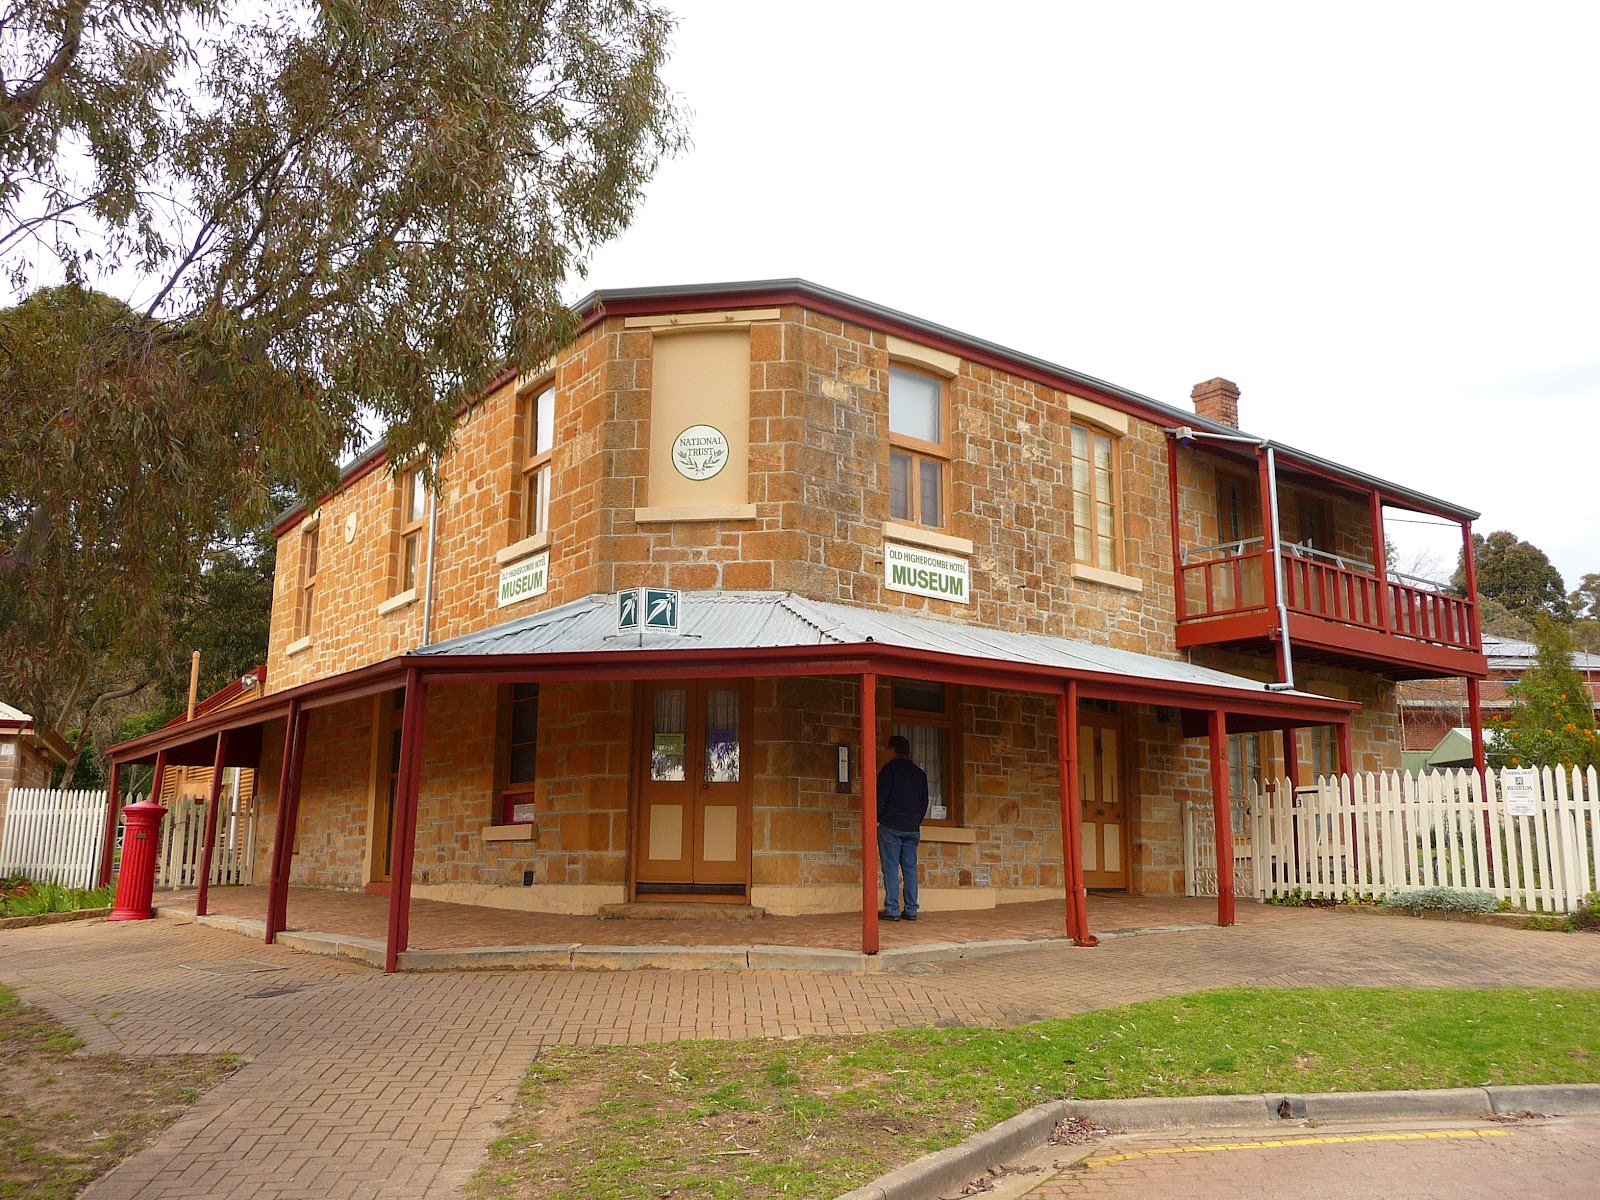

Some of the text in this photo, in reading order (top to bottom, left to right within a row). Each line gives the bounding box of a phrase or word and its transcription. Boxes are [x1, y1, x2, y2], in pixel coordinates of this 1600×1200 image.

[679, 437, 723, 446] NATIONAL
[687, 448, 714, 457] TRUST
[534, 557, 547, 569] HOTEL
[889, 549, 966, 574] OLD HIGHERCOMBE HOTEL
[501, 569, 543, 601] MUSEUM
[892, 564, 963, 596] MUSEUM
